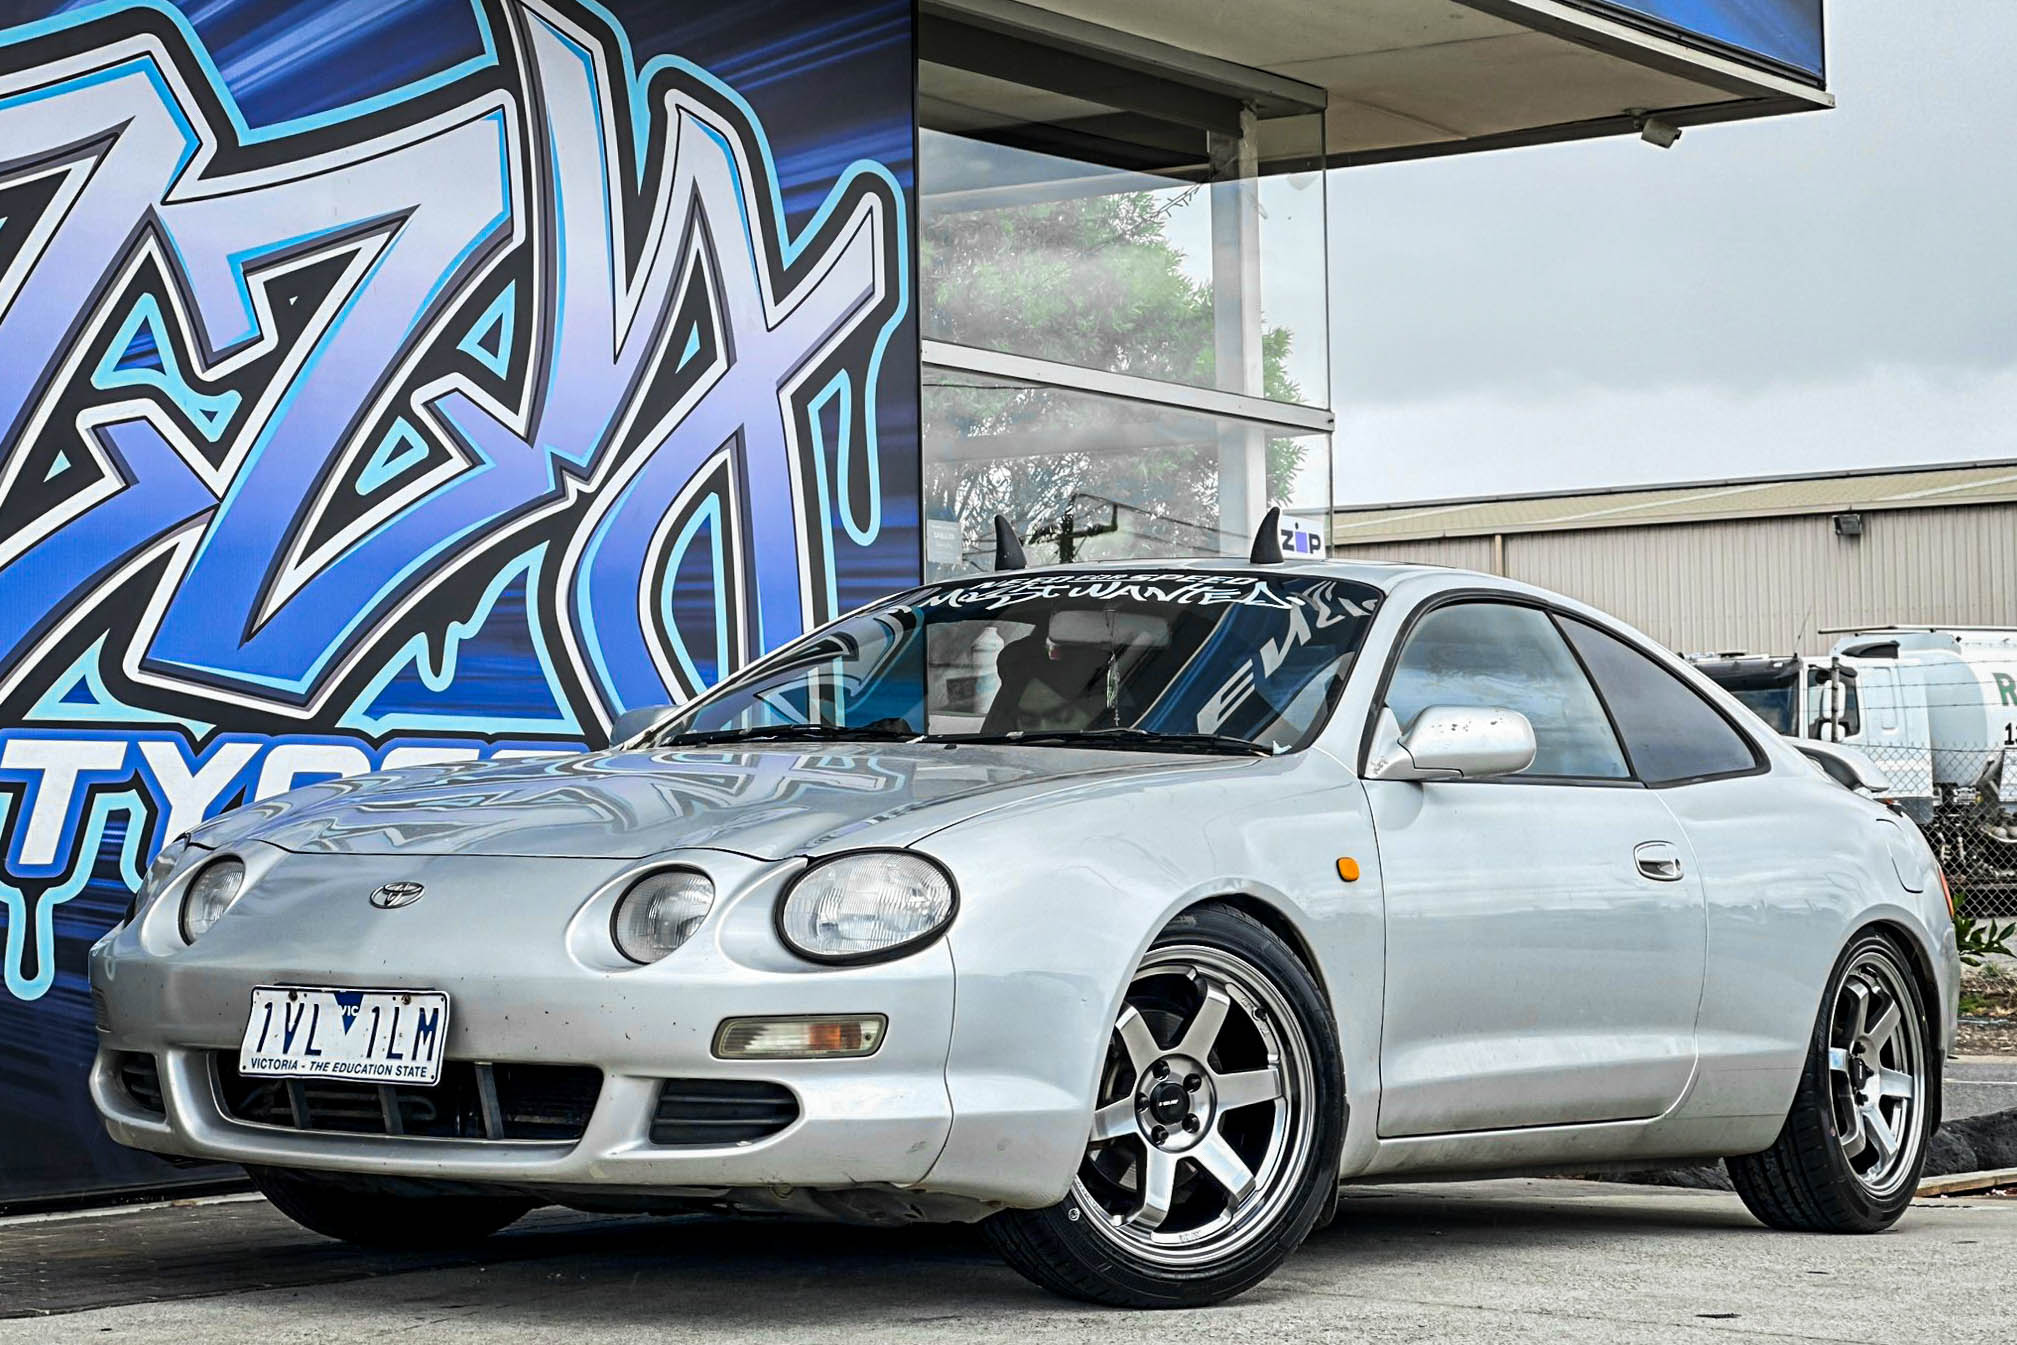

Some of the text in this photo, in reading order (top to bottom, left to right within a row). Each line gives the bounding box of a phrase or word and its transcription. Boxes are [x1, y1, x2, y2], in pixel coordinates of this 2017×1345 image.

[969, 574, 1075, 590] NEED
[1122, 573, 1260, 585] SPEED
[339, 1004, 360, 1017] VIC
[256, 1002, 439, 1062] 1VL 1LM
[251, 1057, 298, 1071] VICTORIA
[309, 1061, 331, 1073] THE
[331, 1061, 394, 1076] EDUCATION
[395, 1065, 428, 1078] STATE
